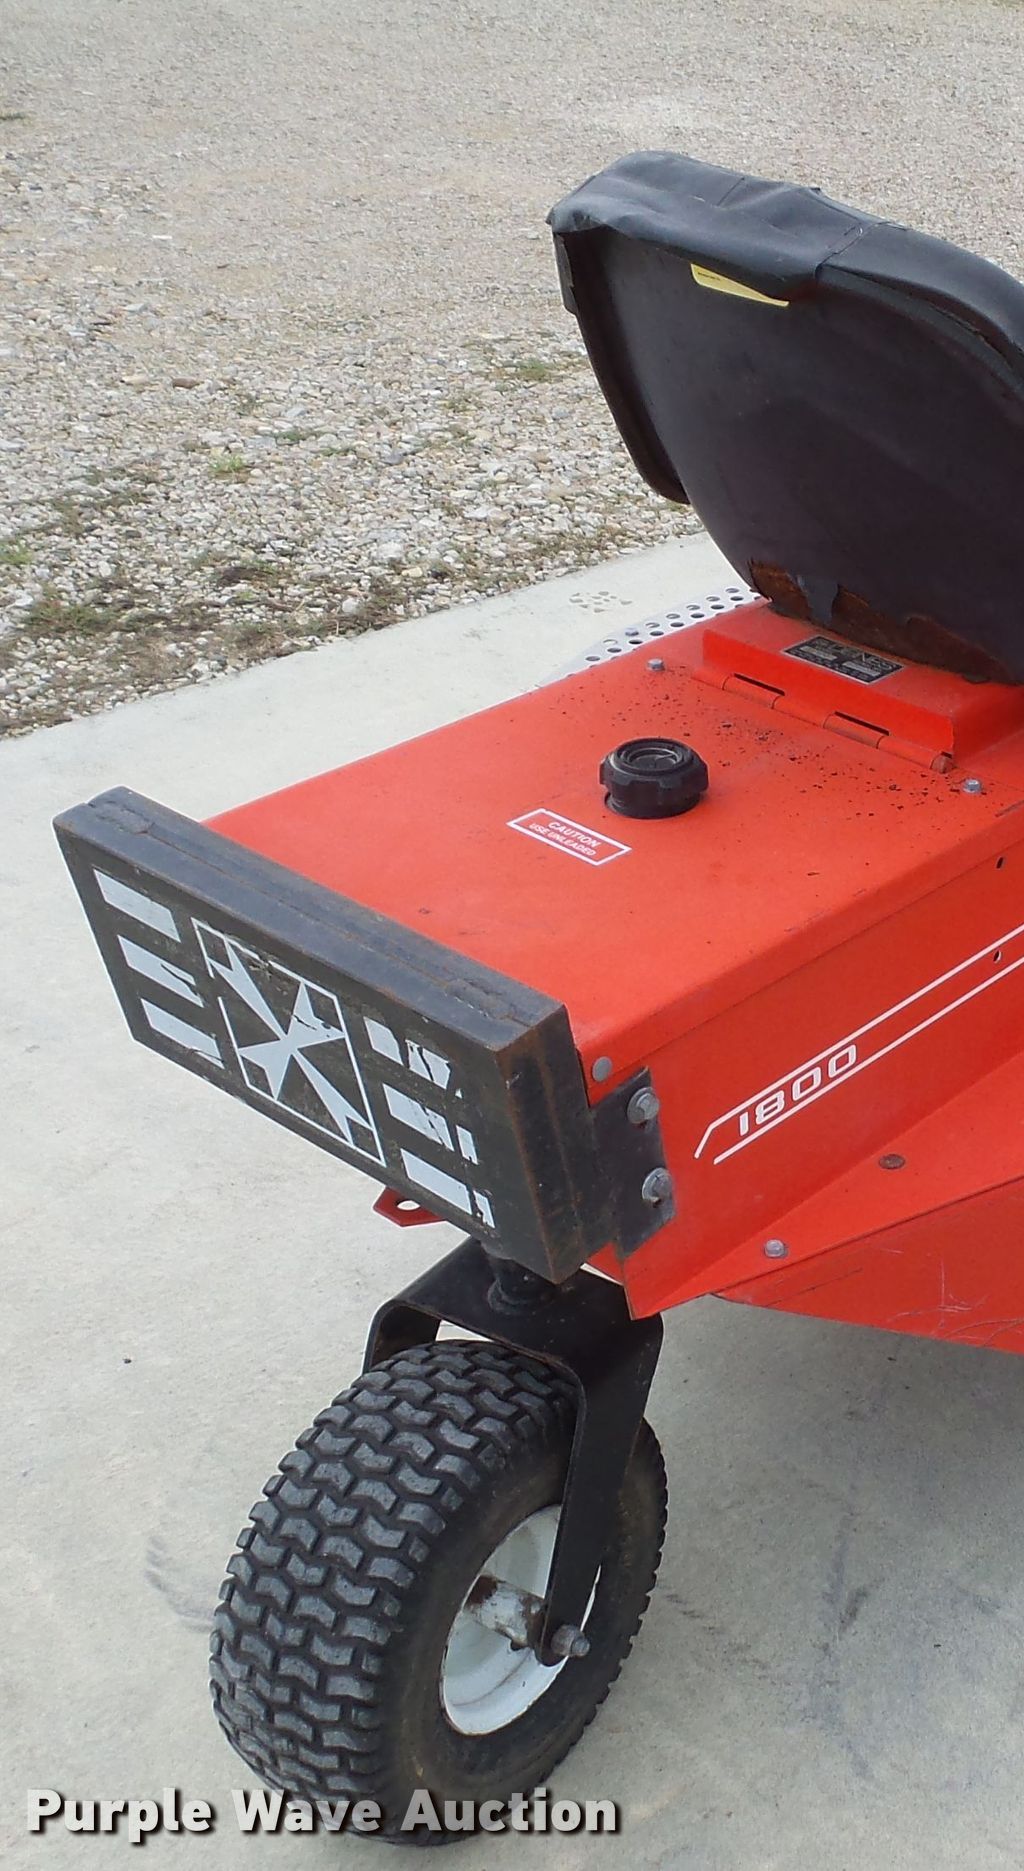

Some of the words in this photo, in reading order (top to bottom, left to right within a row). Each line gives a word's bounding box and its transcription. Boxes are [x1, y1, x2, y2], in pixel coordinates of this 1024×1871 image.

[529, 823, 549, 837] USE
[547, 830, 597, 856] UNLEADED
[548, 821, 601, 847] CAUTION
[739, 1044, 856, 1136] 1800
